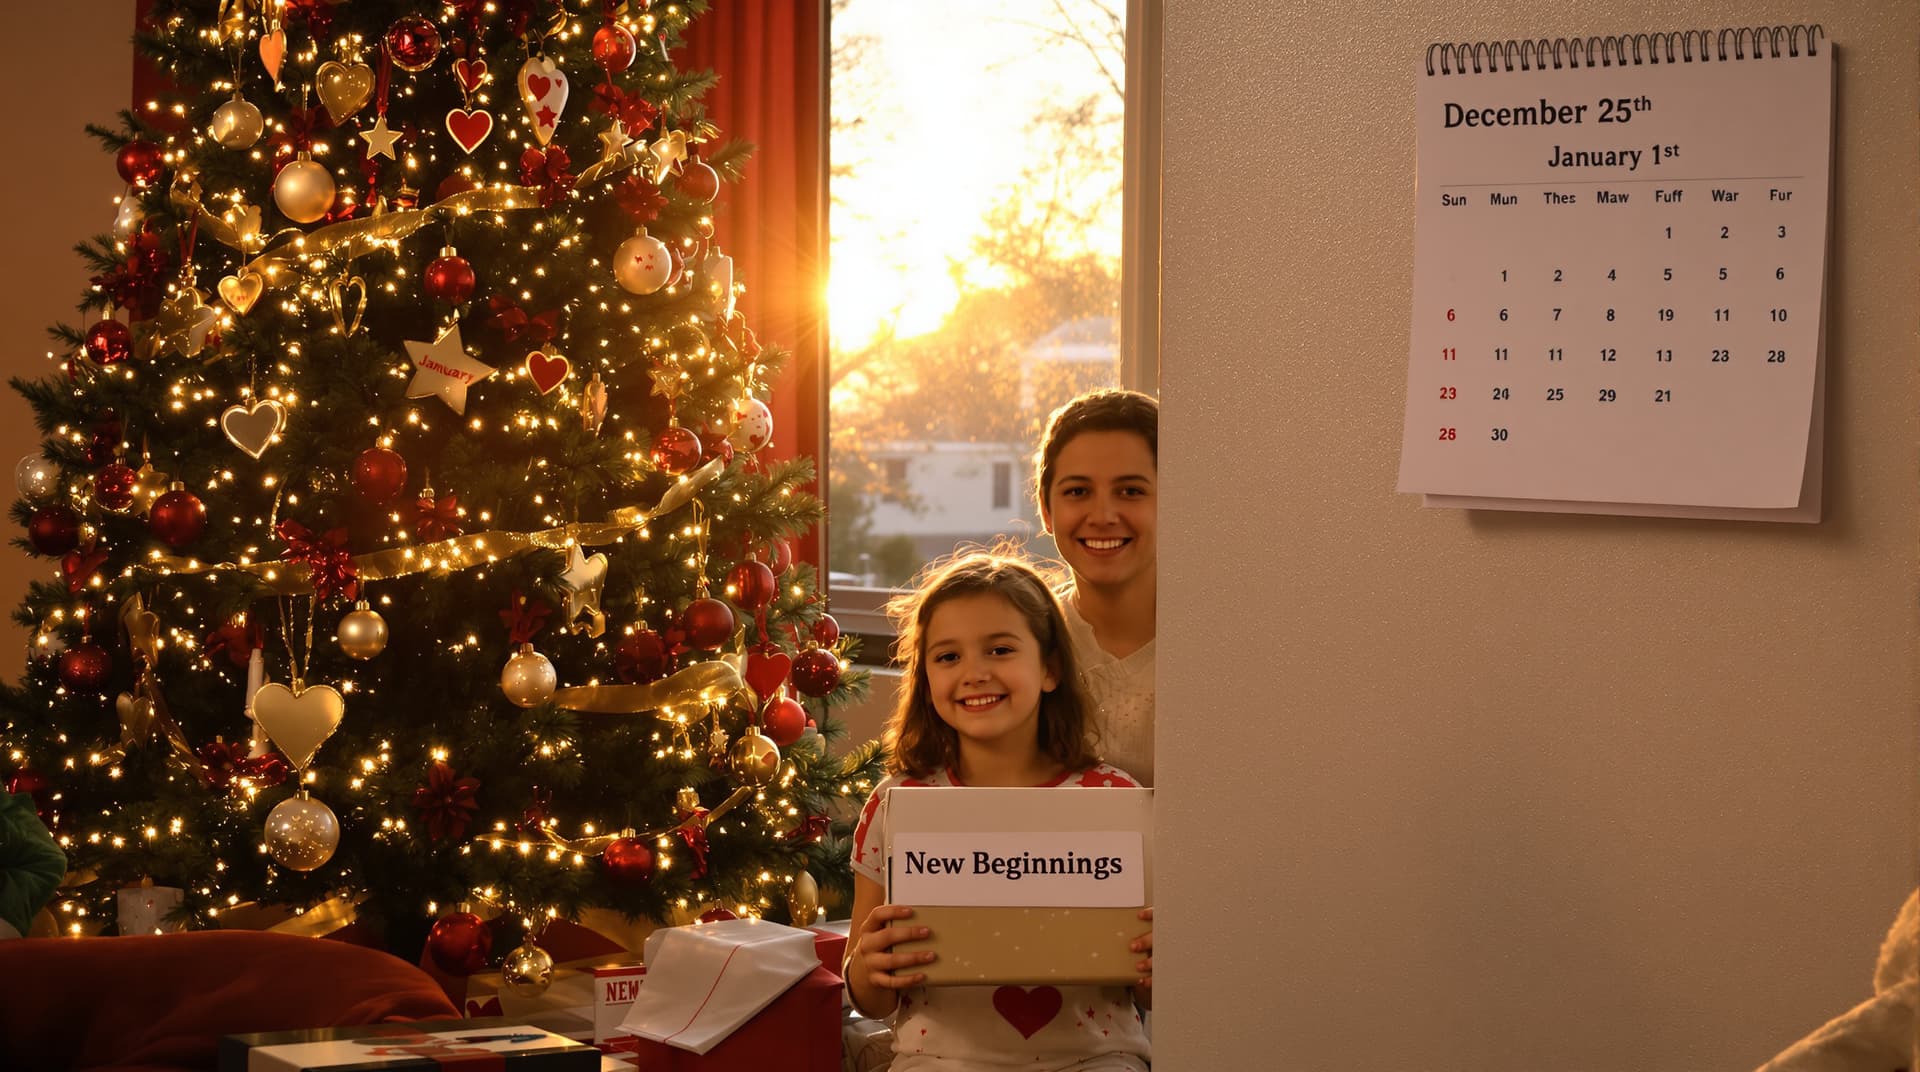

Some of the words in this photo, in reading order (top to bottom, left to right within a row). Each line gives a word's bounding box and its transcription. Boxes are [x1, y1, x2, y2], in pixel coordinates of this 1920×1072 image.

[1443, 98, 1588, 129] December
[1597, 95, 1652, 125] 25th
[1547, 144, 1643, 172] January
[1651, 144, 1680, 166] 1st
[1441, 193, 1467, 207] Sun
[1490, 192, 1518, 206] Mun
[1543, 191, 1577, 205] Thes
[1596, 190, 1630, 204] Maw
[1655, 189, 1684, 204] Fuff
[1711, 189, 1740, 203] War
[1769, 188, 1793, 202] Fur
[1664, 226, 1673, 240] 1
[1720, 225, 1729, 239] 2
[1777, 225, 1786, 239] 3
[1500, 269, 1509, 283] 1
[1553, 269, 1563, 282] 2
[1607, 268, 1617, 282] 4
[1663, 267, 1673, 282] 5
[1718, 267, 1728, 281] 5
[1775, 266, 1785, 281] 6
[1446, 308, 1456, 322] 6
[1499, 308, 1509, 322] 6
[1552, 307, 1562, 322] 7
[1606, 308, 1616, 322] 8
[1657, 308, 1675, 322] 19
[1714, 308, 1730, 322] 11
[1770, 308, 1788, 323] 10
[1442, 347, 1456, 361] 11
[1494, 347, 1508, 361] 11
[1548, 348, 1563, 361] 11
[1600, 348, 1617, 362] 12
[1767, 349, 1786, 364] 28
[1439, 386, 1457, 401] 23
[1546, 388, 1565, 402] 25
[1598, 388, 1617, 403] 29
[1654, 389, 1671, 403] 21
[1490, 427, 1509, 442] 30
[904, 851, 966, 875] New
[972, 849, 1123, 881] Beginnings
